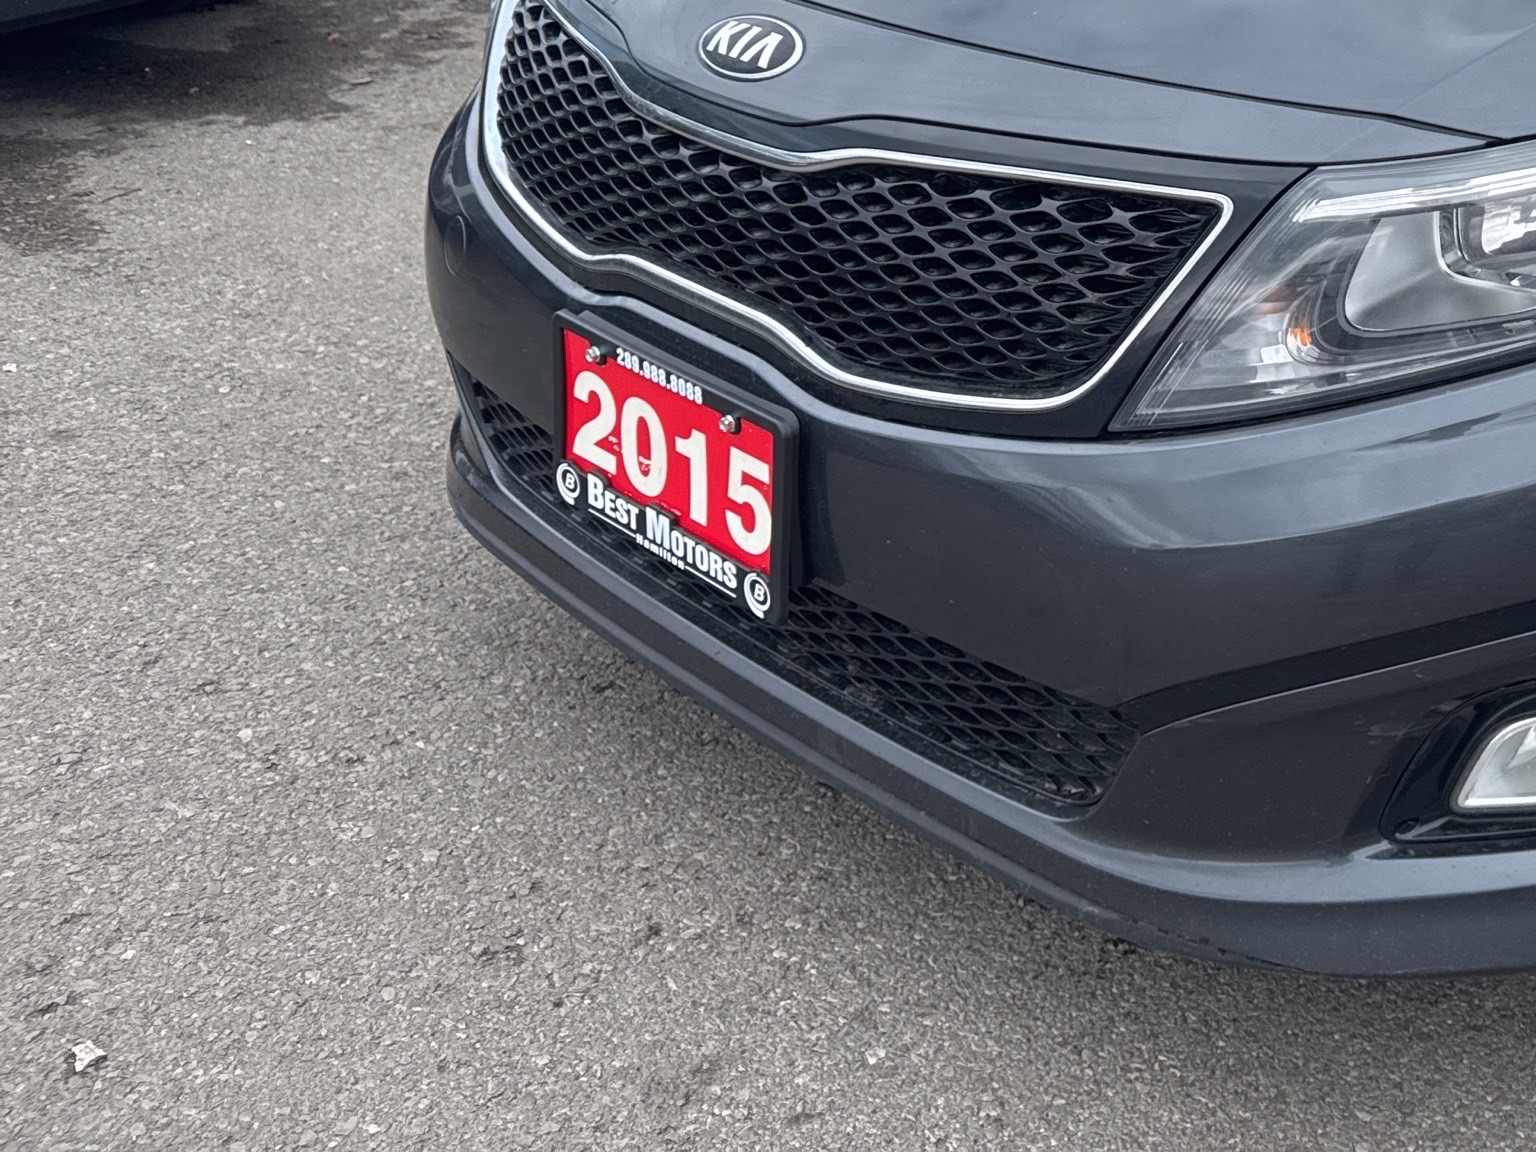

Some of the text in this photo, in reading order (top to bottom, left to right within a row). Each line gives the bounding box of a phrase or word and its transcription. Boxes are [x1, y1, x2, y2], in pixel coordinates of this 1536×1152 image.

[706, 20, 784, 69] KIA
[616, 347, 703, 405] 289.988.8088
[572, 370, 772, 556] 2015
[635, 533, 685, 570] Hamilton
